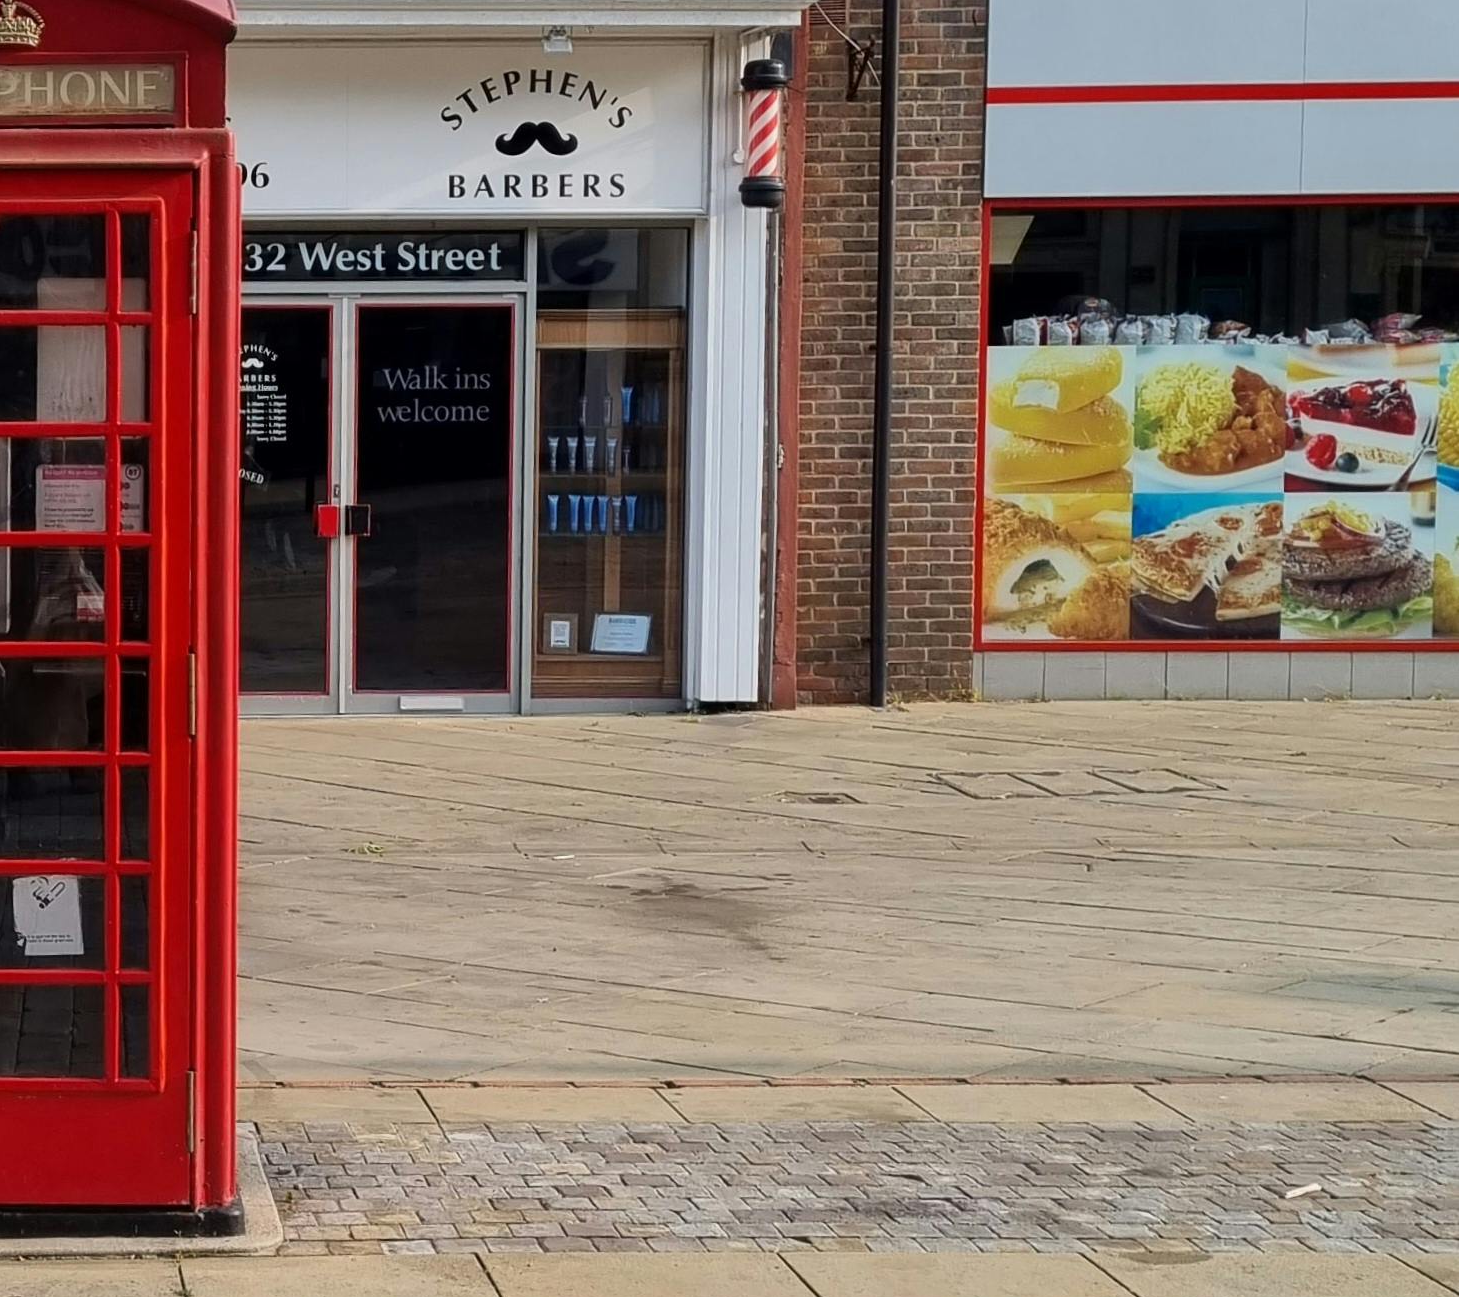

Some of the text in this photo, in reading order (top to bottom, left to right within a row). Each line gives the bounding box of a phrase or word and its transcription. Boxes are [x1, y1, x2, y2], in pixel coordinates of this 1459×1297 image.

[441, 69, 633, 131] STEPHEN'S
[448, 174, 625, 198] BARBERS
[244, 241, 502, 271] 32 West Street
[241, 344, 278, 361] PHEN'S
[241, 374, 276, 383] RBERS
[382, 365, 491, 391] Walk ins
[377, 398, 490, 422] welcome
